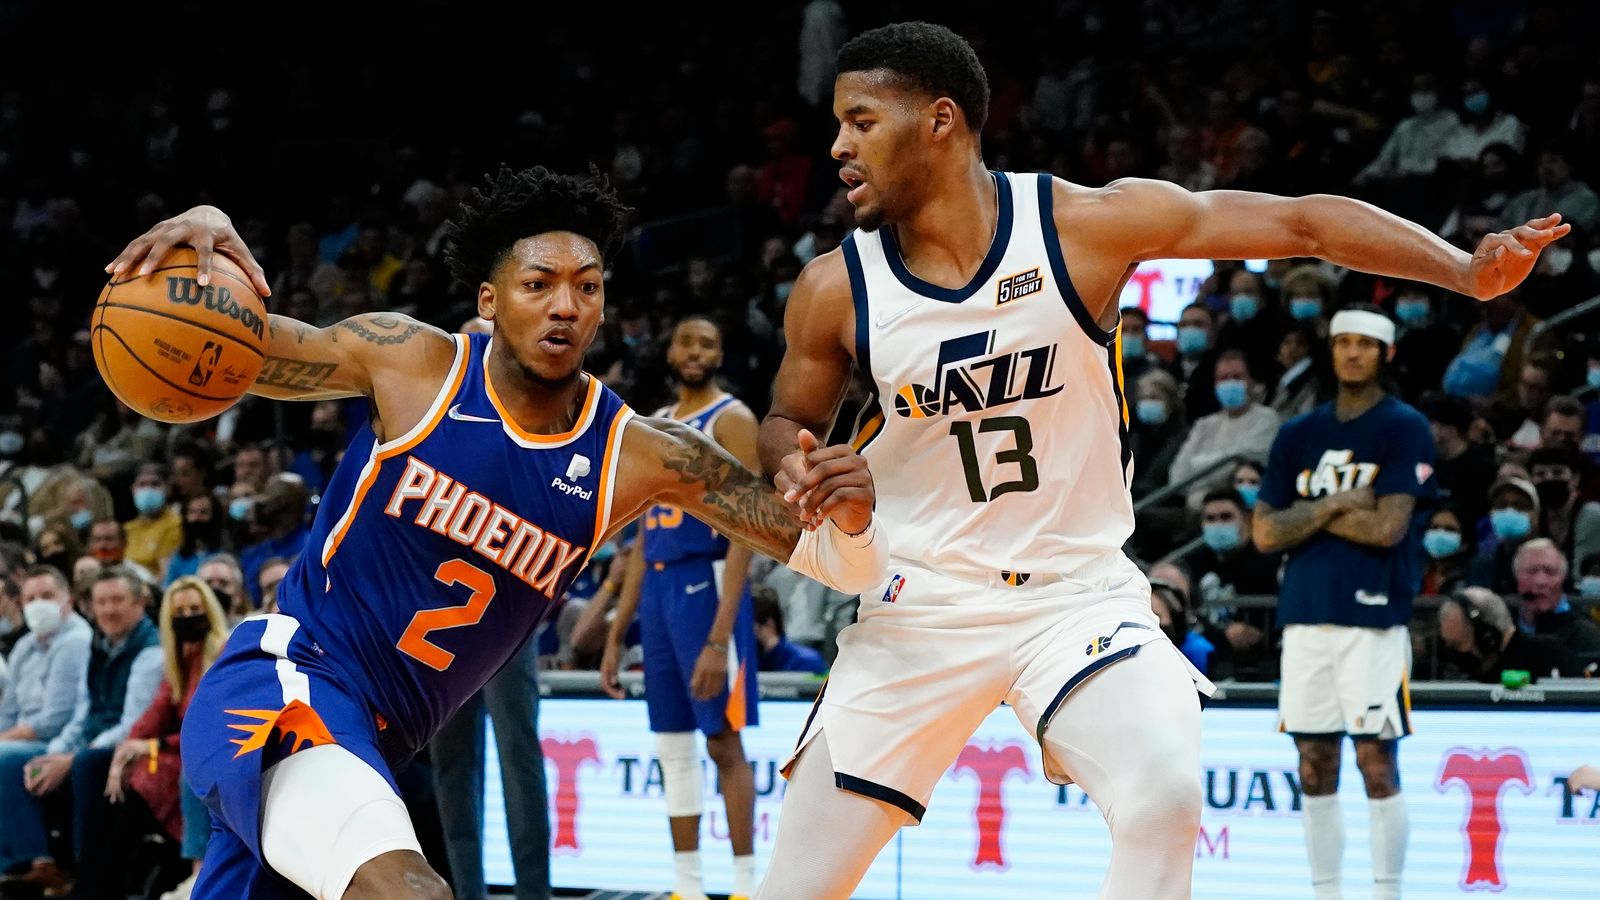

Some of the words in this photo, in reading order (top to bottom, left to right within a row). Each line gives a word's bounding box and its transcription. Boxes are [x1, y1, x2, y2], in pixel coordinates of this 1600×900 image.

[1000, 280, 1011, 302] 5
[1013, 280, 1040, 298] FIGHT
[1015, 274, 1026, 283] FOR
[1026, 270, 1037, 279] THE
[166, 276, 264, 342] Wilson
[895, 329, 1064, 419] JAZZ
[949, 415, 1039, 503] 13
[1296, 448, 1380, 498] JAZZ
[551, 477, 592, 501] PayPal
[384, 455, 586, 599] PHOENIX
[396, 558, 496, 672] 2
